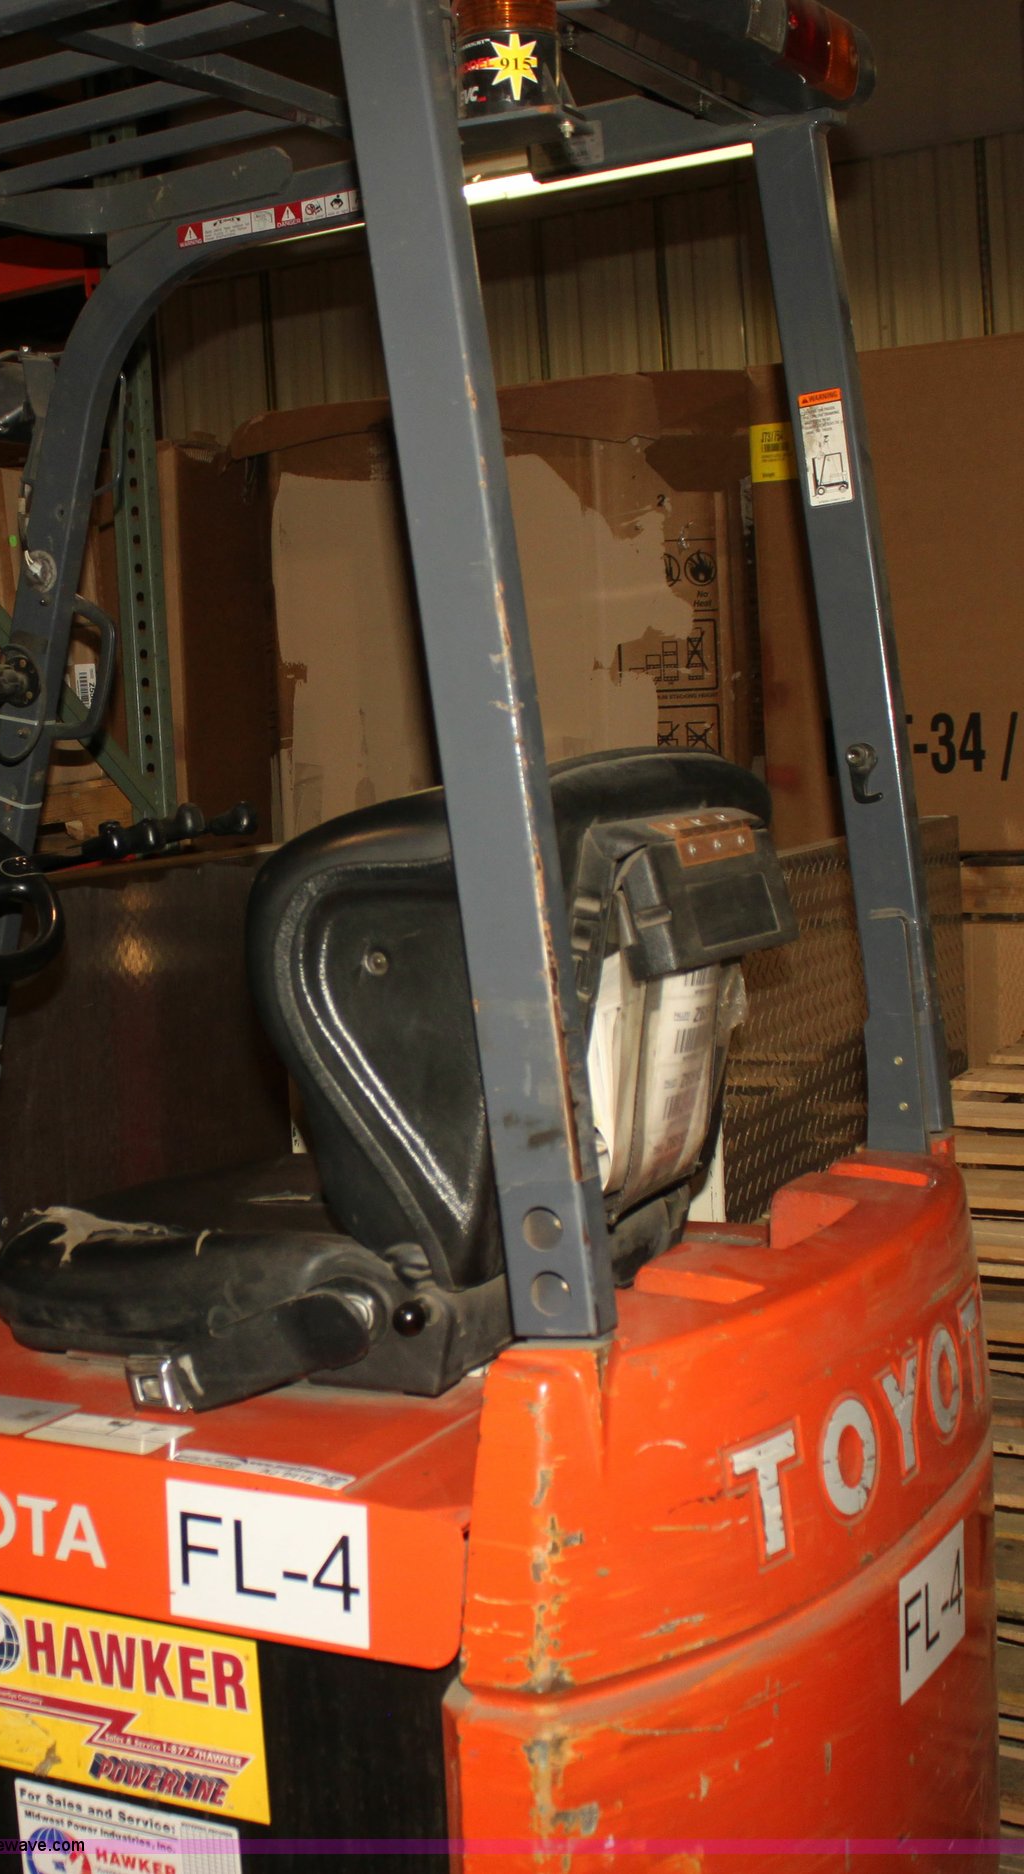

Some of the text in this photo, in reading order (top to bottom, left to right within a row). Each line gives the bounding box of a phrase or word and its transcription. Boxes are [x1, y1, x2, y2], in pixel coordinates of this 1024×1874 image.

[500, 58, 532, 70] 915
[179, 238, 202, 248] WARNING
[277, 218, 302, 229] DANGER
[808, 391, 838, 401] WARNING
[905, 711, 986, 775] -34
[728, 1294, 988, 1558] TOYOT
[180, 1511, 360, 1612] FL-4
[904, 1548, 964, 1672] FL-4
[24, 1619, 248, 1712] HAWKER
[104, 1733, 124, 1745] Sales
[134, 1739, 161, 1751] Service
[162, 1743, 242, 1768] 1-877-7HAWKER
[90, 1753, 230, 1807] POWERLINE
[19, 1788, 40, 1802] For
[46, 1792, 82, 1812] Sales
[88, 1803, 113, 1818] and
[117, 1809, 176, 1834] Service:
[24, 1810, 176, 1854] Midwest Power Industries, Inc.
[95, 1848, 176, 1874] HAWKER
